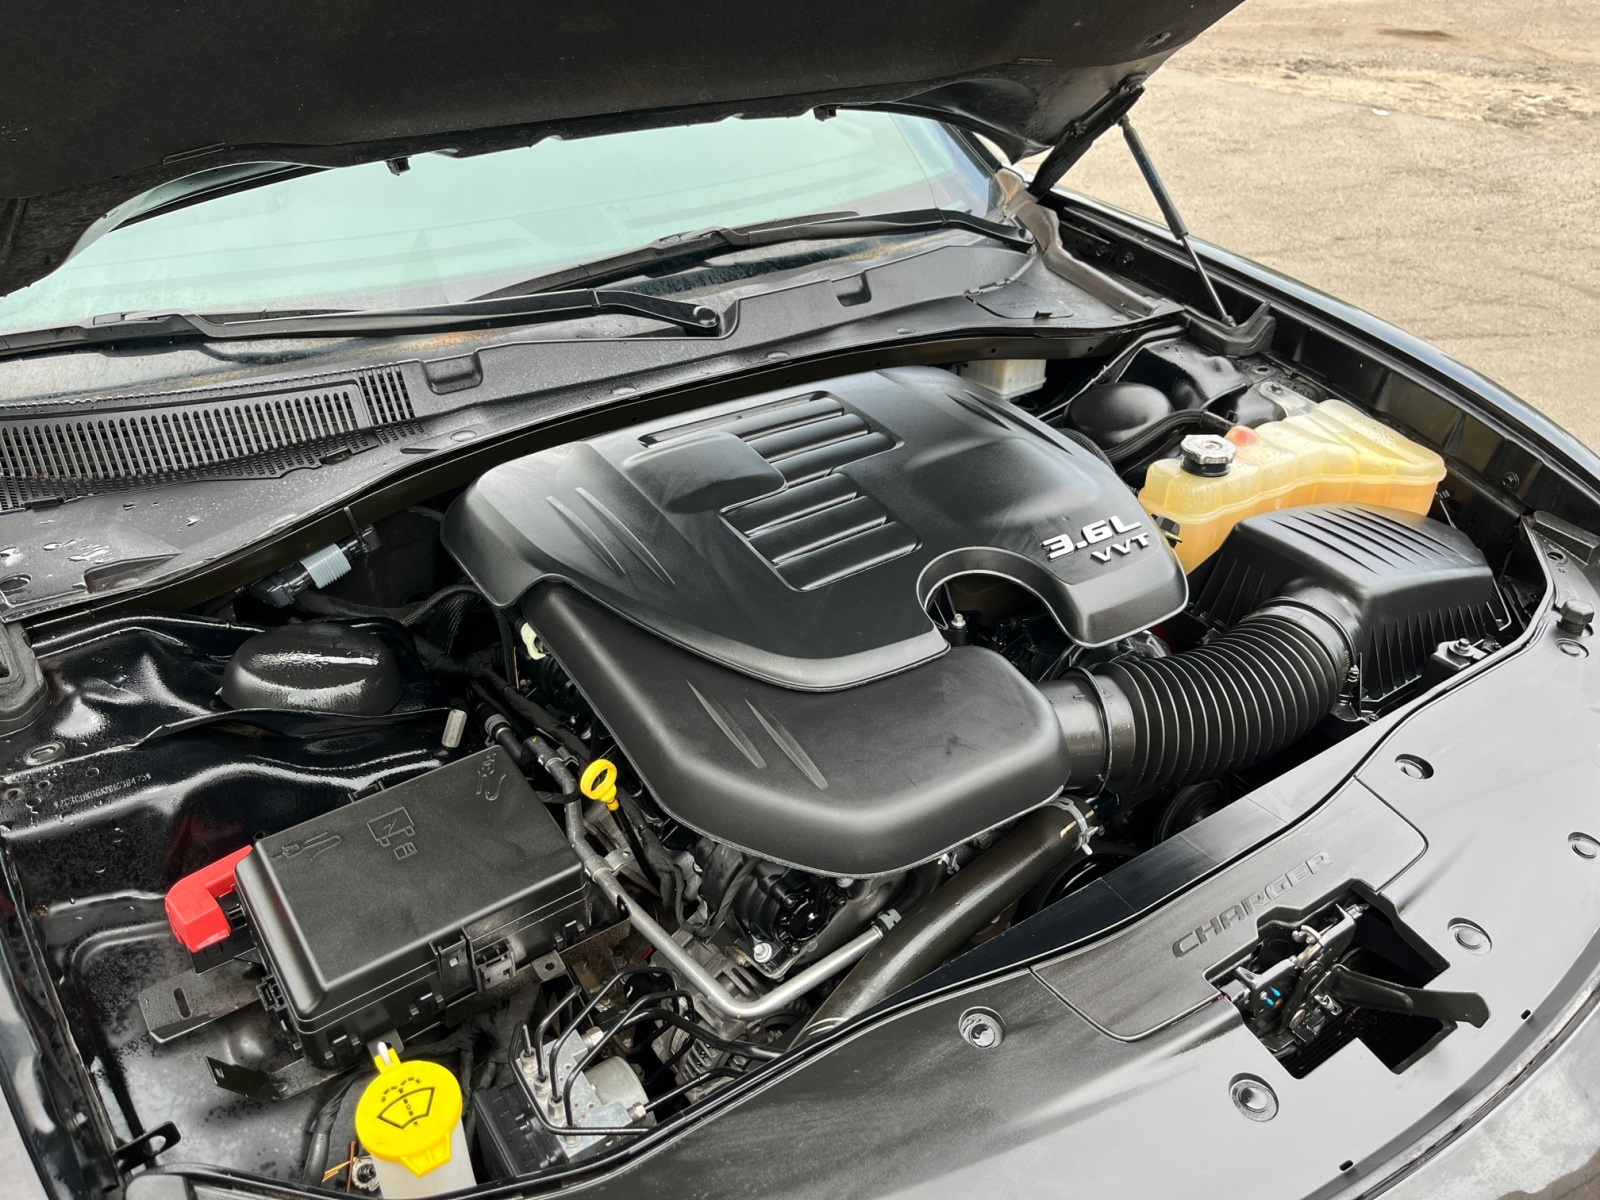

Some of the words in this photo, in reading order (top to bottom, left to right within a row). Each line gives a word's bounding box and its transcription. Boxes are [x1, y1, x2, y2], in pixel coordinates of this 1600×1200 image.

[1041, 515, 1142, 561] 3.6L
[1090, 532, 1149, 564] VVT
[1171, 851, 1335, 959] CHARGER
